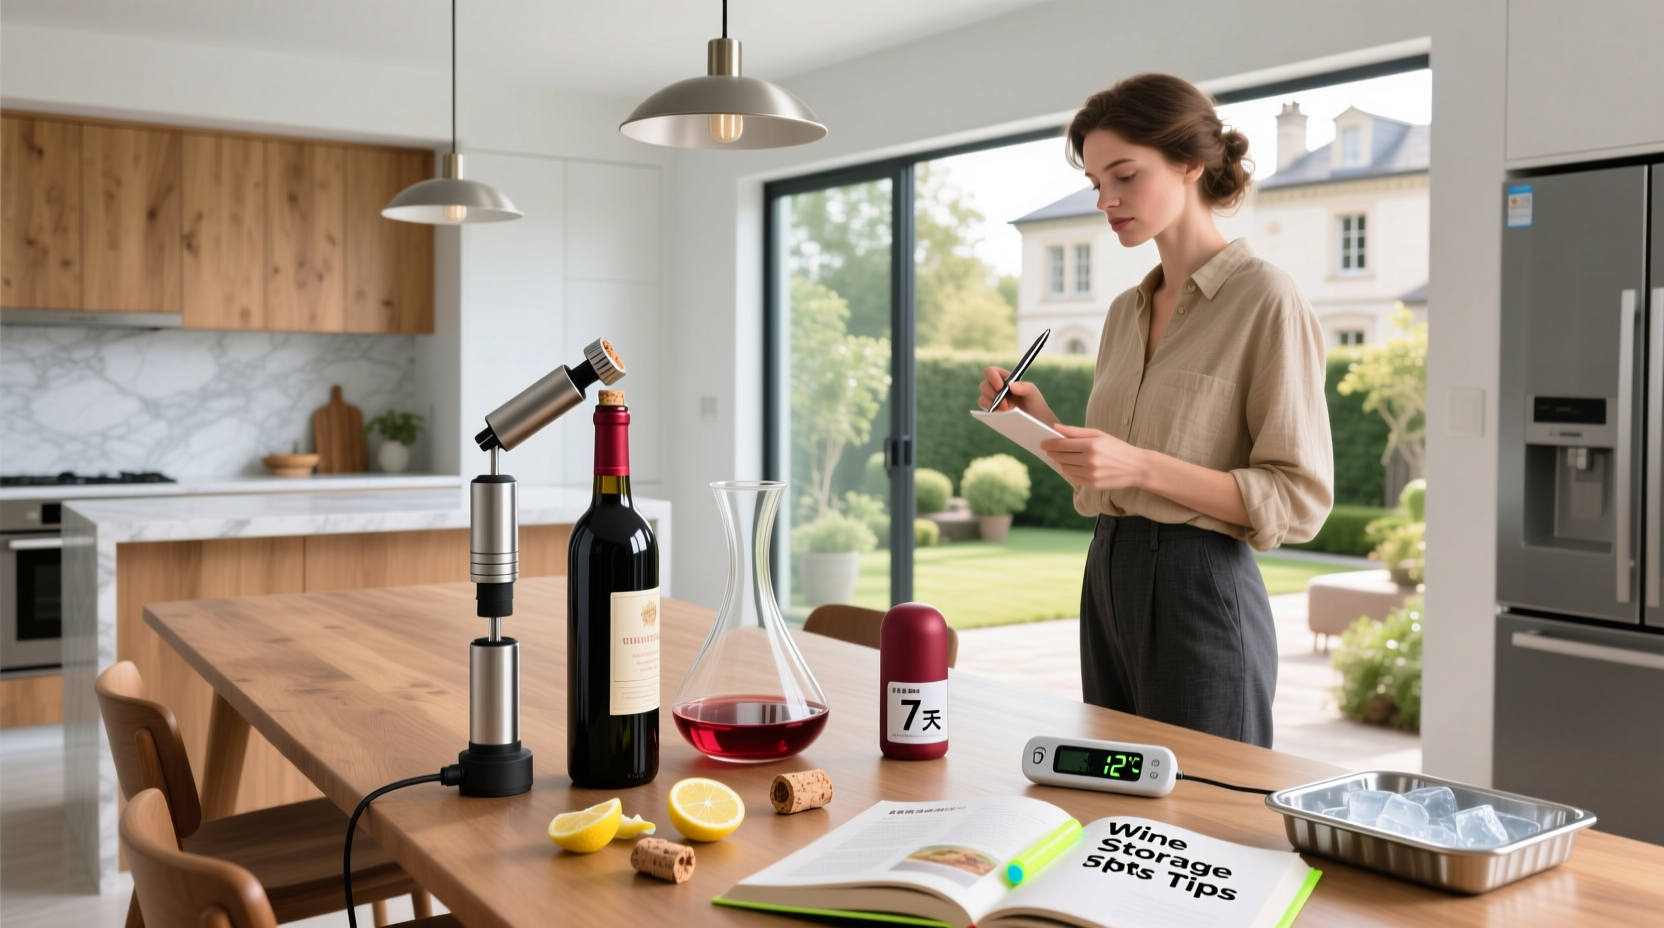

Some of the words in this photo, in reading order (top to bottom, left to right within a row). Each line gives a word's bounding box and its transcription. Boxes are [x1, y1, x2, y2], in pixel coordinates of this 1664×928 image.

[901, 699, 941, 731] 7天
[1109, 822, 1188, 850] Wine
[1097, 838, 1233, 879] Storage
[1167, 870, 1238, 901] Tips
